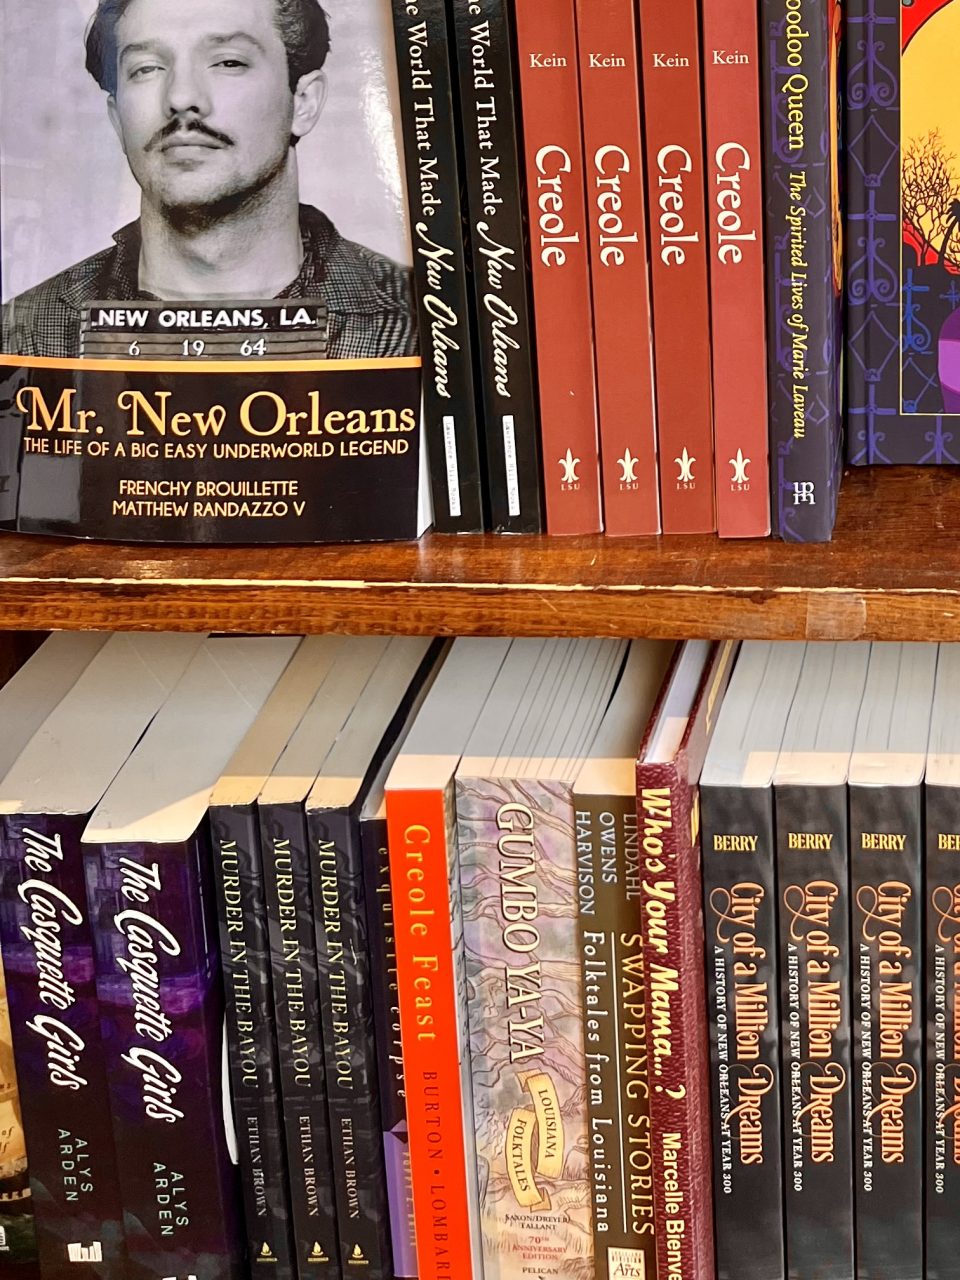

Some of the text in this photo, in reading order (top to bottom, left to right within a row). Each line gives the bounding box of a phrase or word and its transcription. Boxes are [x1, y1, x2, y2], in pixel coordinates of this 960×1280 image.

[406, 21, 432, 90] World
[530, 54, 567, 68] Kein
[414, 97, 435, 150] That
[419, 157, 441, 217] Made
[535, 145, 580, 267] Creole
[416, 222, 455, 290] New
[99, 308, 316, 330] NEW ORLEANS, LA.
[423, 295, 460, 399] Orleans
[16, 386, 416, 436] Mr. New Orleans
[25, 437, 408, 459] THE LIFE OF A BIG EASY UNDERWORLD LEGEND
[113, 501, 305, 516] MATTHEW RANDAZZO V
[120, 481, 298, 496] FRENCHY BROUILLETTE
[713, 835, 758, 850] BERRY
[404, 824, 439, 1042] Creole Feast
[496, 802, 545, 1064] GUMBO YA-YA
[710, 882, 764, 943] City
[18, 828, 87, 1091] The Casquette Girls
[220, 839, 259, 1089] MURDER IN THE BAYOU
[733, 932, 766, 959] of
[734, 963, 756, 975] a
[734, 981, 768, 1060] Million
[539, 1089, 555, 1158] LOUISIANA
[512, 1118, 531, 1193] FOLKTALES
